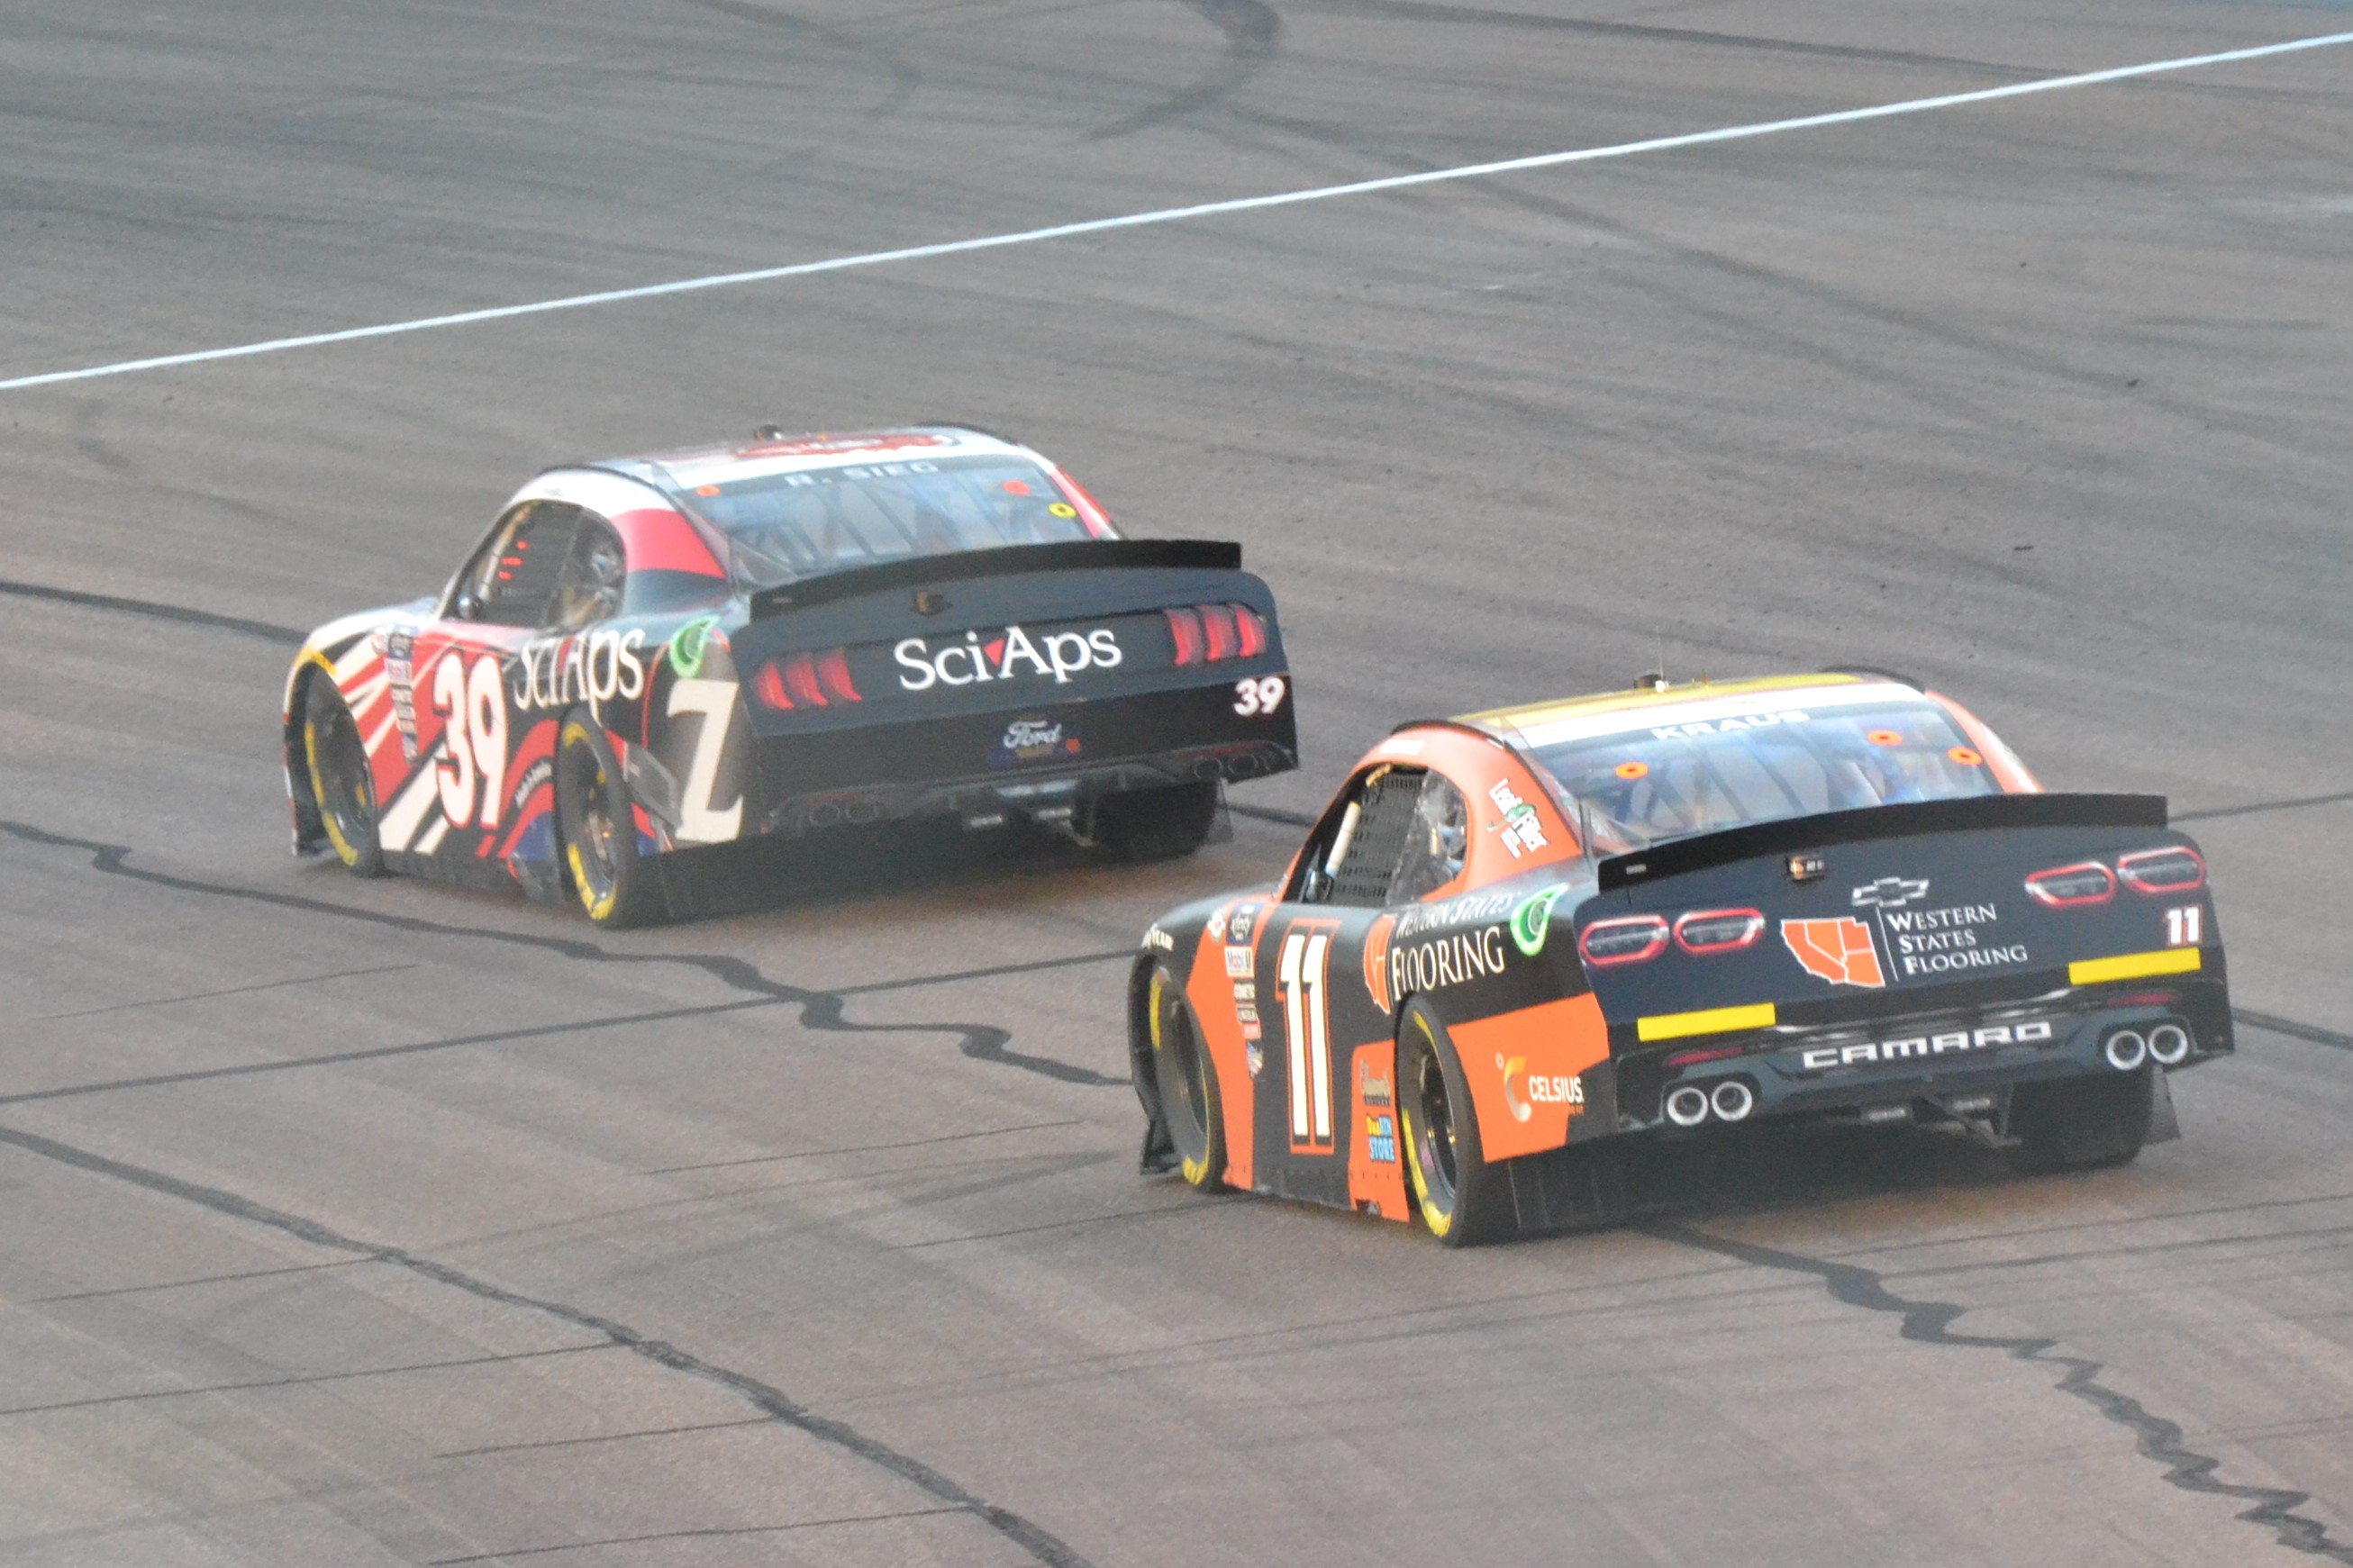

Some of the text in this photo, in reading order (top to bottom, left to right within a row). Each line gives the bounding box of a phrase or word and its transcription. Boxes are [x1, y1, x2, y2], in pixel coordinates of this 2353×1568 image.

[894, 626, 1122, 691] SciAps
[1233, 675, 1286, 717] 39
[432, 648, 507, 829] 39
[1003, 721, 1062, 749] Ford
[1650, 710, 1810, 739] KRAUS
[1886, 902, 1997, 932] WESTERN
[2166, 905, 2201, 945] 11
[1898, 928, 1976, 955] STATES
[1903, 944, 2028, 975] FLOORING
[1392, 925, 1505, 1002] FLOORING
[1276, 928, 1335, 1146] 11
[1803, 1021, 2052, 1069] CAMARO
[1529, 1074, 1584, 1104] CELSIUS
